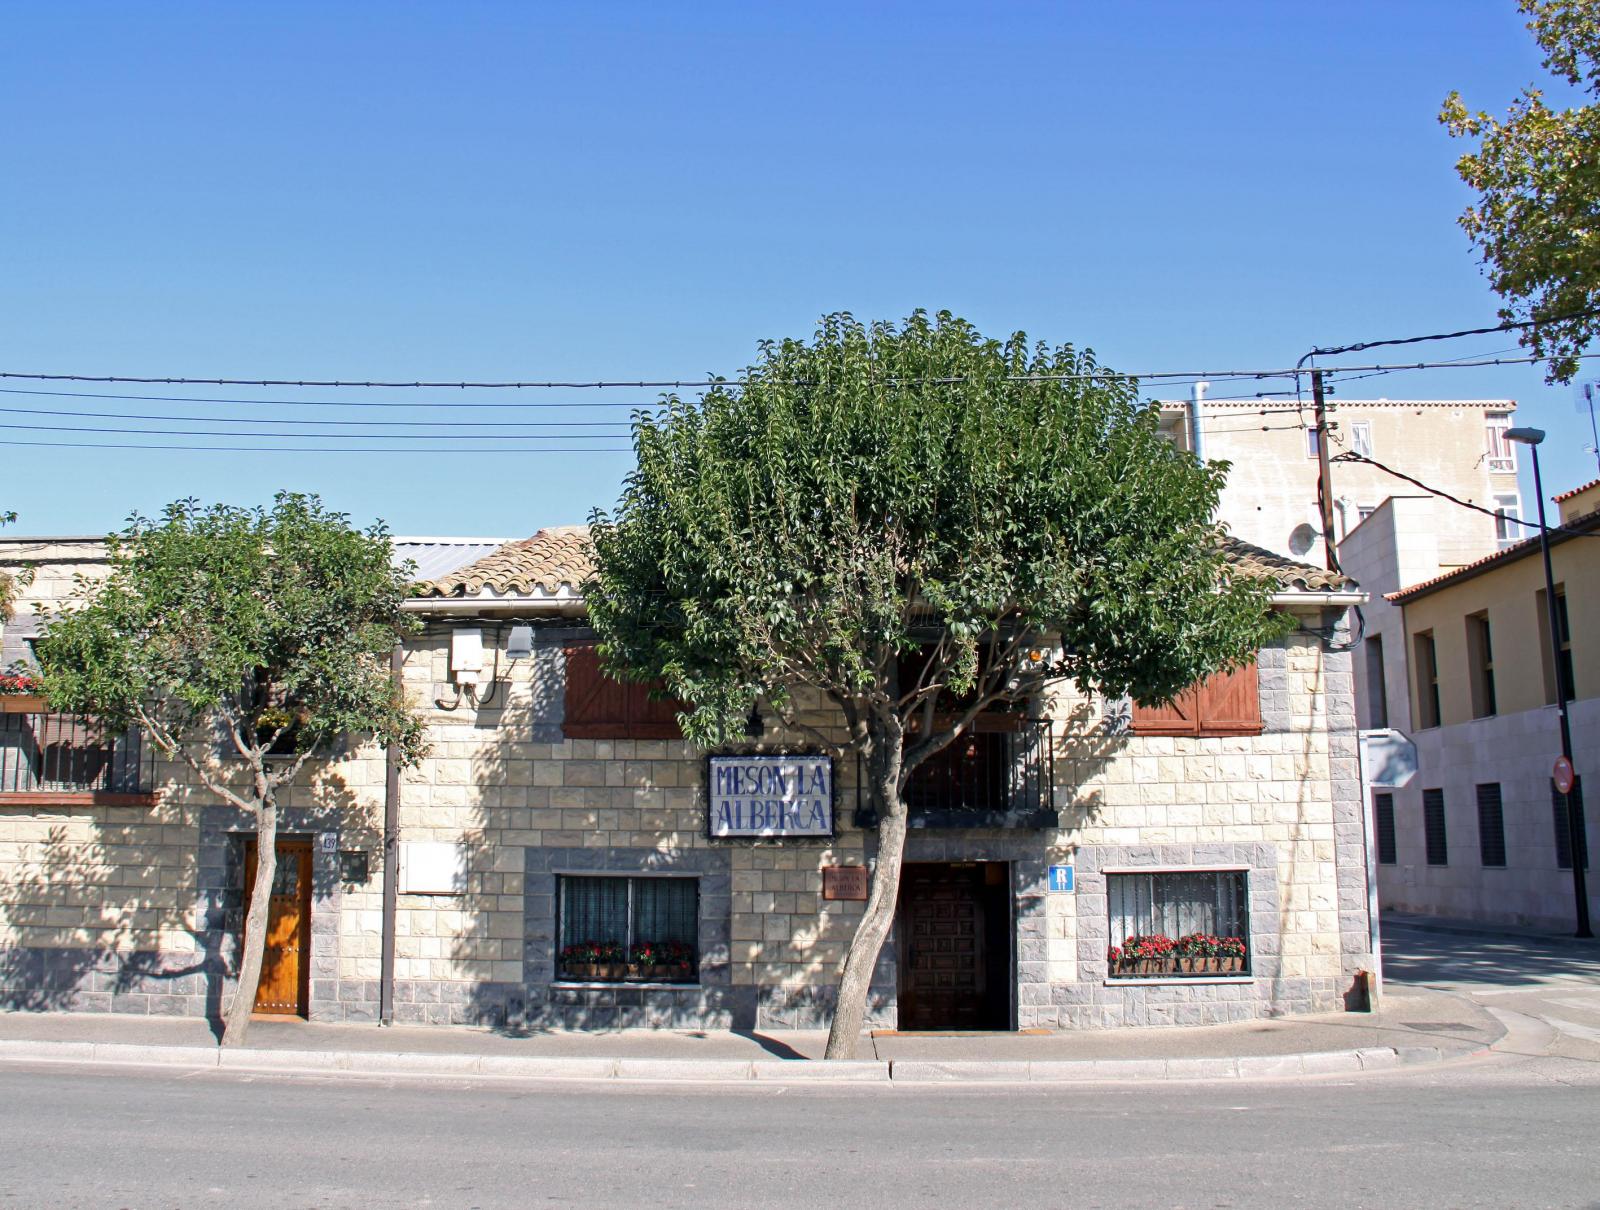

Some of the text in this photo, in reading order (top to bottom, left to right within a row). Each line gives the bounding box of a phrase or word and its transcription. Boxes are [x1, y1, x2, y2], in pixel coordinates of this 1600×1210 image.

[717, 765, 827, 795] MESON LA
[717, 800, 827, 829] ALBERCA
[1056, 868, 1068, 883] R
